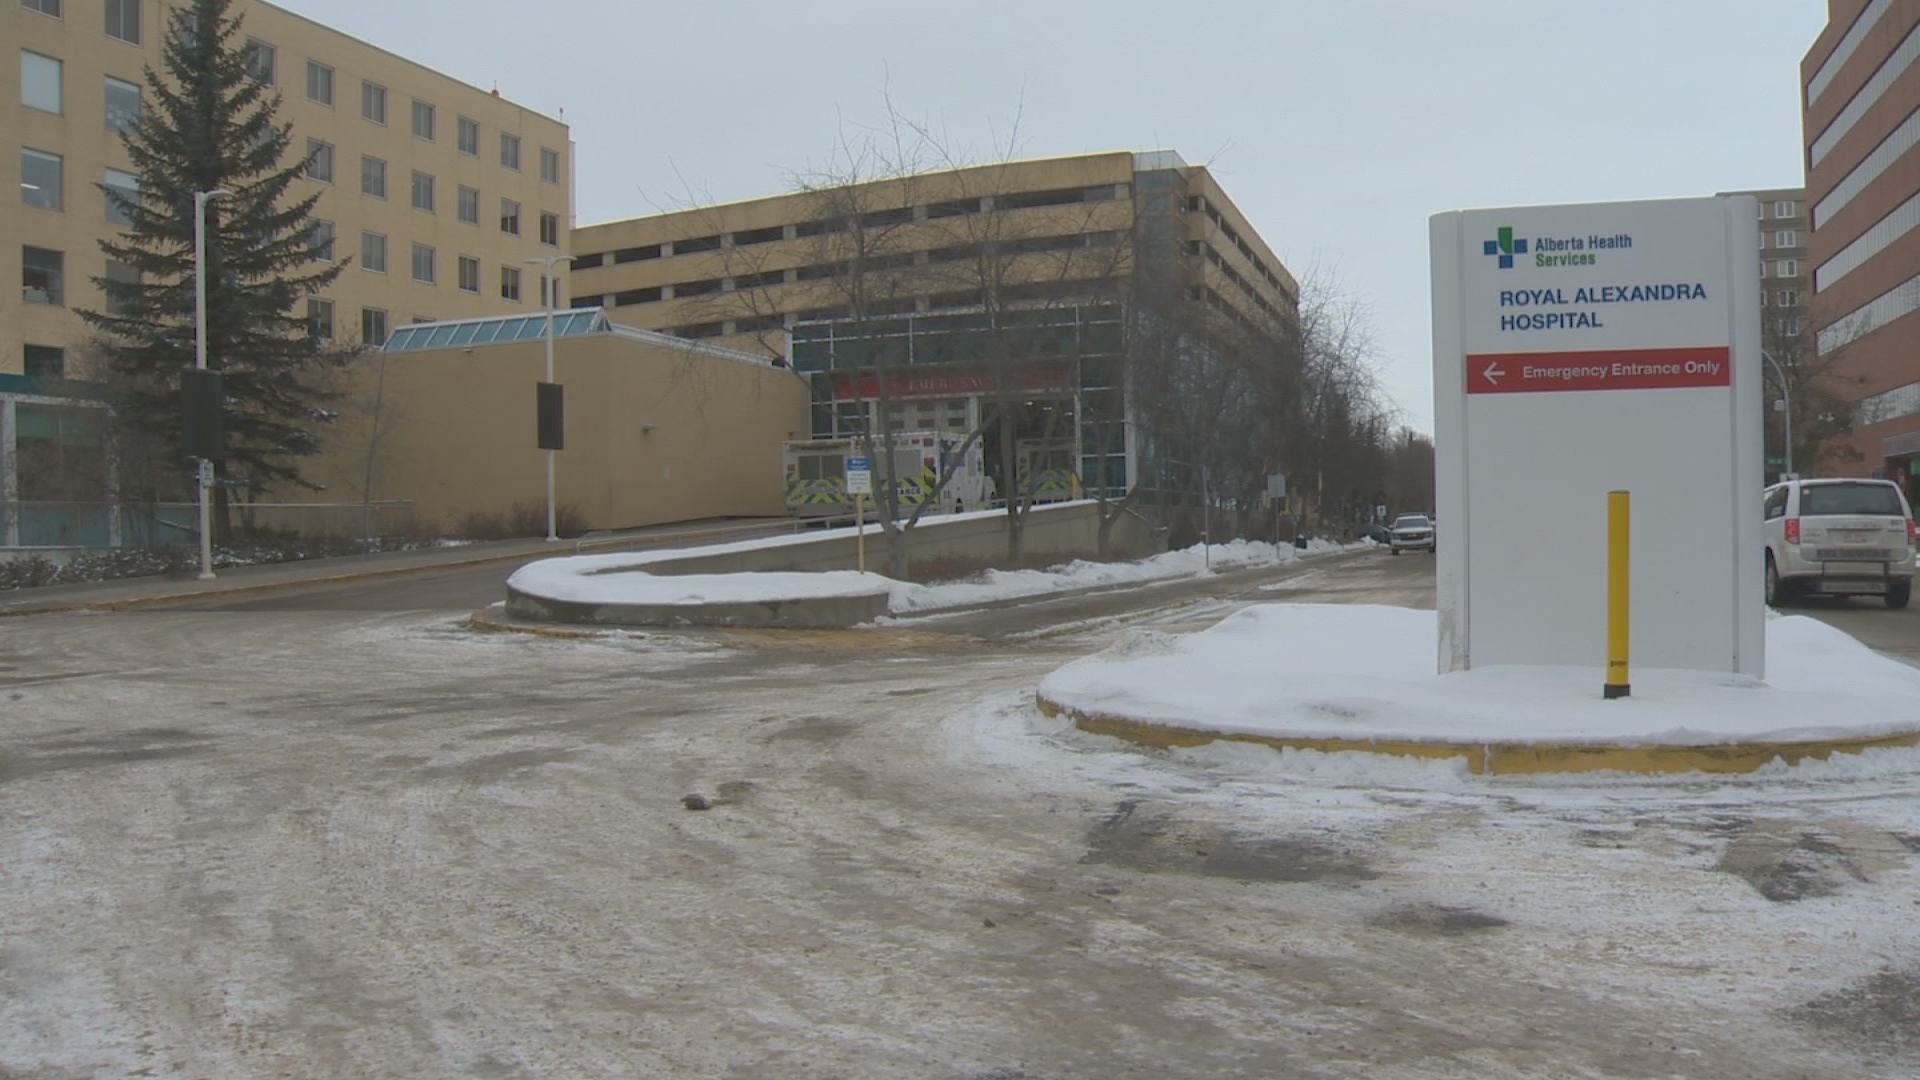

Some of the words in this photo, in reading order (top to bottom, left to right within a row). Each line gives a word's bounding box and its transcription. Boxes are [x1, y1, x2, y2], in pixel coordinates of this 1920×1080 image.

[1535, 237, 1584, 252] Alberta
[1588, 233, 1632, 249] Health
[1535, 252, 1596, 268] Services
[1500, 288, 1569, 307] ROYAL
[1574, 283, 1707, 304] ALEXANDRA
[1501, 311, 1604, 331] HOSPITAL
[1522, 365, 1608, 380] Emergency
[1611, 362, 1681, 376] Entrance
[1684, 360, 1720, 375] Only
